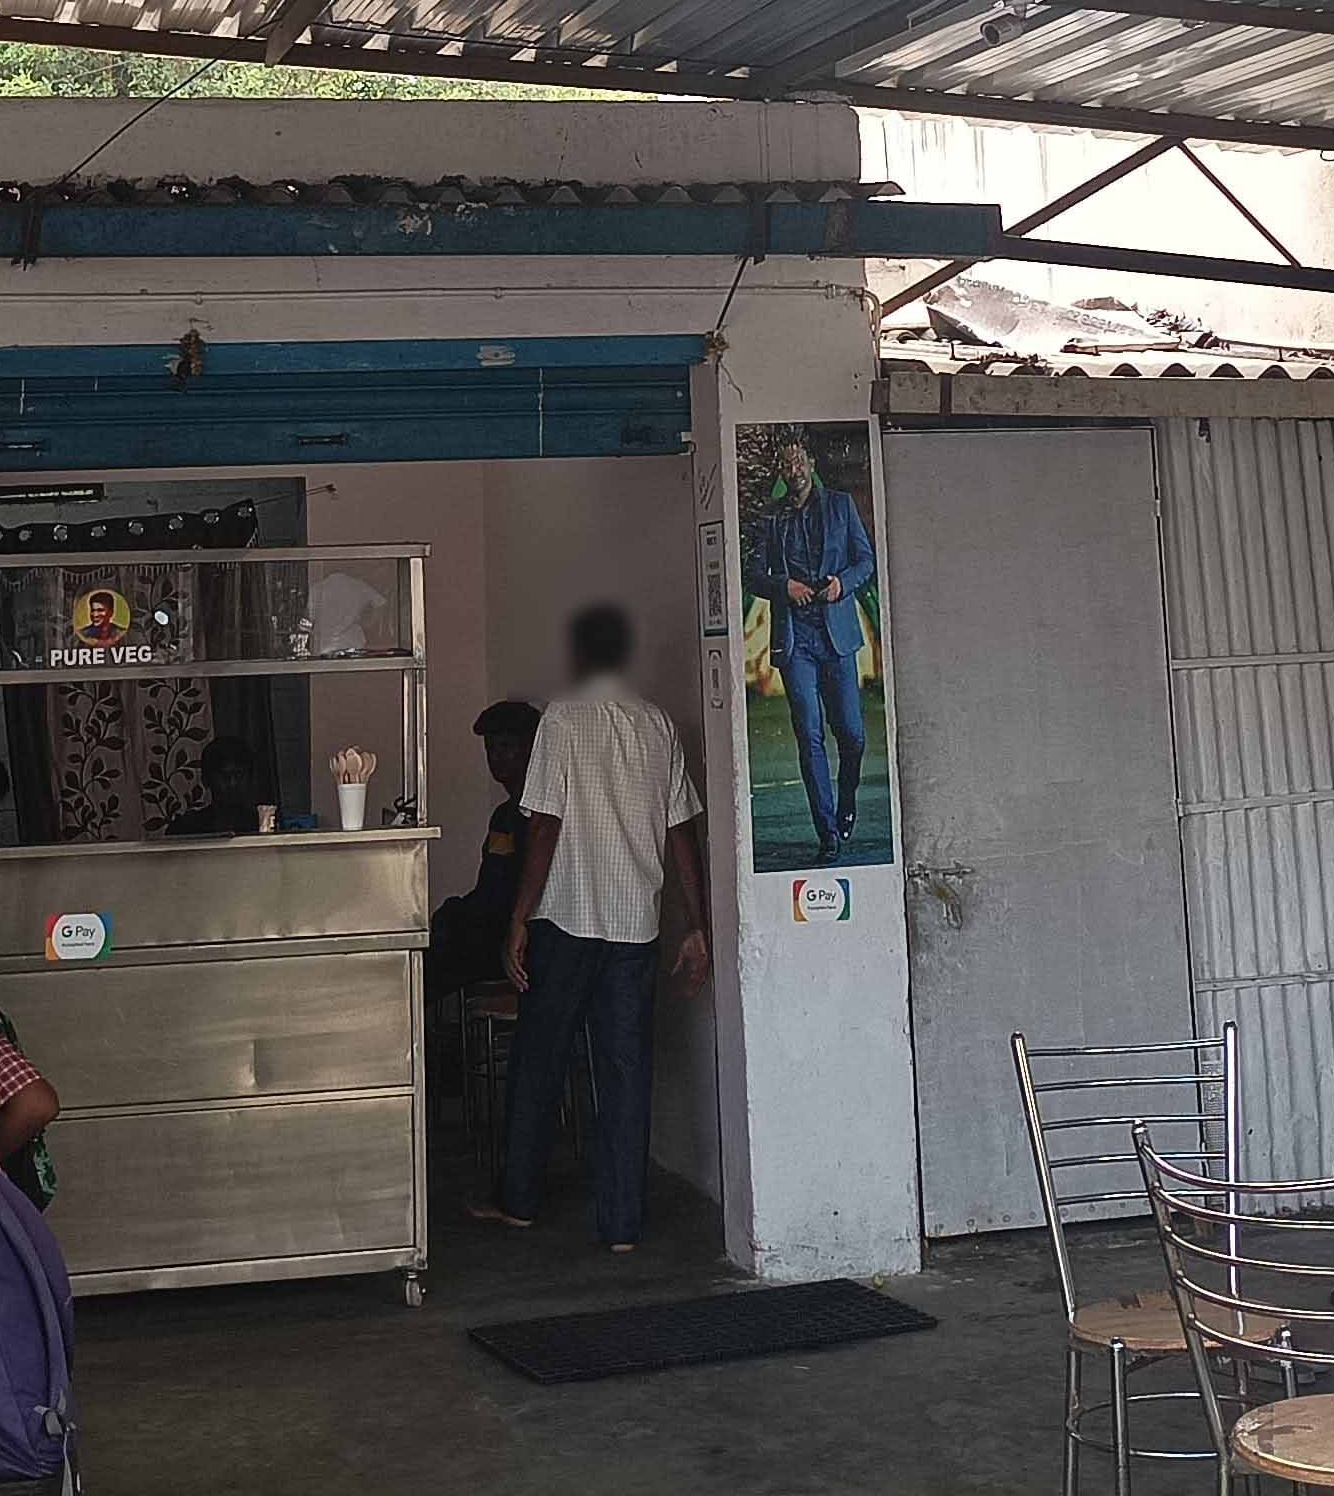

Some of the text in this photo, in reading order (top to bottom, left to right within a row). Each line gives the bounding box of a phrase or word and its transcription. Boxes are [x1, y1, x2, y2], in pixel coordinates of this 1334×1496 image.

[50, 645, 152, 667] PURE VEG
[75, 925, 96, 939] Pay
